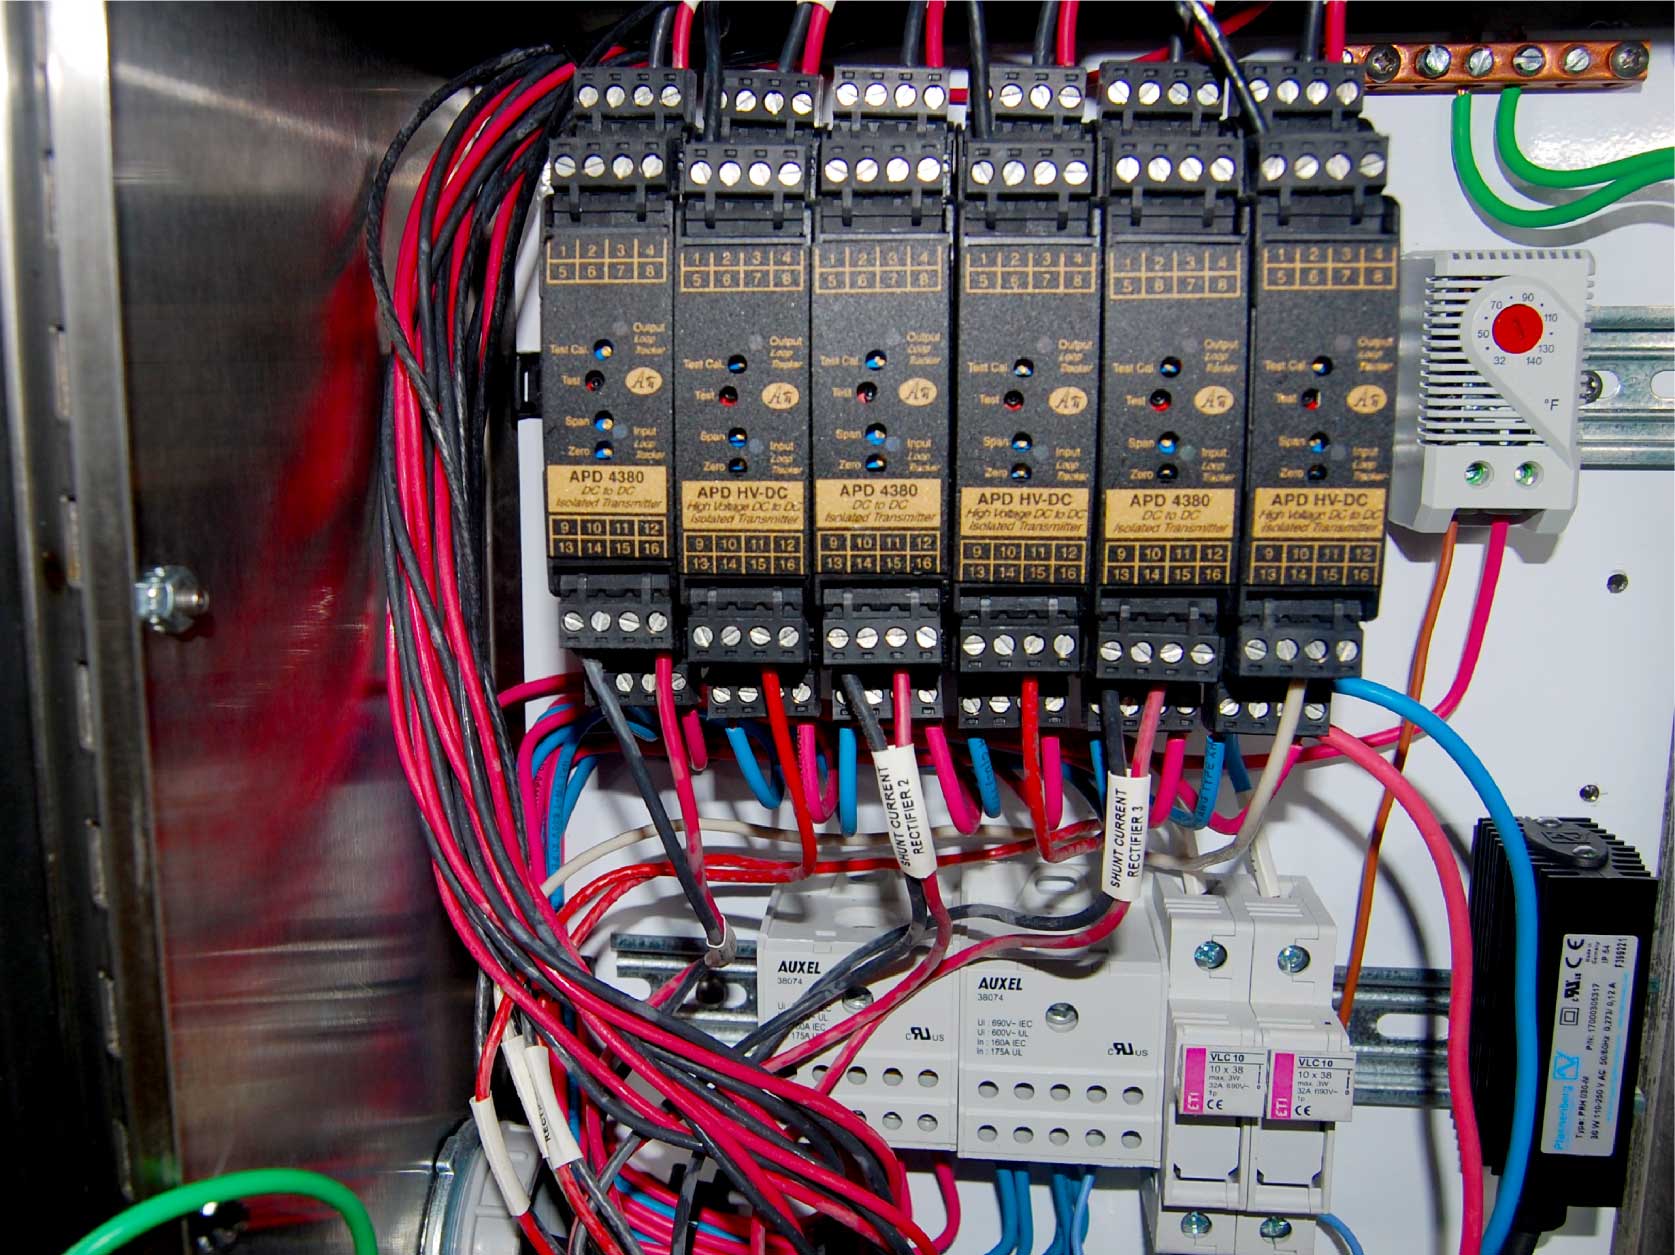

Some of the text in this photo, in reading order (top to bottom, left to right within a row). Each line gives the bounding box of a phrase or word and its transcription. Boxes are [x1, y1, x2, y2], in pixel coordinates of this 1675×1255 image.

[561, 245, 654, 256] 1 2 3 4
[559, 266, 654, 278] 5 6 7 8
[1522, 293, 1534, 302] 90
[1491, 301, 1502, 309] 70
[1478, 330, 1489, 338] 50
[1539, 345, 1554, 353] 130
[1493, 357, 1505, 365] 32
[1526, 357, 1542, 365] 140
[1545, 399, 1558, 411] °F
[836, 430, 862, 441] Span
[907, 439, 931, 450] Input
[984, 436, 1009, 448] Span
[568, 447, 589, 456] Zero
[703, 462, 725, 472] Zero
[839, 461, 861, 470] Zero
[570, 471, 644, 482] APD 4380
[985, 468, 1007, 478] Zero
[1131, 469, 1154, 480] Zero
[581, 486, 635, 495] DC to DC
[697, 487, 788, 498] APD HV-DC
[840, 484, 918, 497] APD 4380
[556, 498, 662, 509] Isolated Transmitter
[978, 493, 1072, 505] APD HV-DC
[1130, 495, 1210, 507] APD 4380
[1272, 494, 1368, 506] APD HV-DC
[687, 503, 711, 512] High
[713, 502, 749, 513] Voltage
[751, 503, 770, 511] DC
[784, 502, 802, 512] DC
[853, 500, 907, 510] DC to DC
[691, 514, 799, 525] Isolated Transmitter
[825, 512, 935, 523] Isolated Transmitter
[967, 509, 990, 520] High
[993, 509, 1028, 520] Voltage
[1031, 509, 1051, 519] DC
[1069, 509, 1088, 520] DC
[1142, 510, 1200, 521] DC to DC
[1259, 510, 1284, 521] High
[1286, 510, 1324, 521] Voltage
[1328, 510, 1347, 520] DC
[1363, 510, 1383, 521] DC
[561, 523, 659, 534] 9 10 11 12
[969, 522, 1082, 532] Isolated Transmitter
[1114, 524, 1228, 534] Isolated Transmitter
[1261, 523, 1378, 533] Isolated Transmitter
[559, 542, 659, 554] 13 14 15 16
[878, 767, 910, 867] SHUNT CURRENT
[898, 779, 924, 855] RECTIFIER 2
[1111, 788, 1127, 888] SHUNT CURRENT
[1128, 817, 1143, 877] RECTIFIER
[778, 961, 821, 974] AUXEL
[978, 977, 1023, 990] AUXEL
[792, 1032, 810, 1040] 175A
[1299, 1059, 1319, 1067] VLC
[1232, 1066, 1244, 1074] 38
[1187, 1093, 1199, 1110] ETI
[1275, 1098, 1287, 1117] ETI
